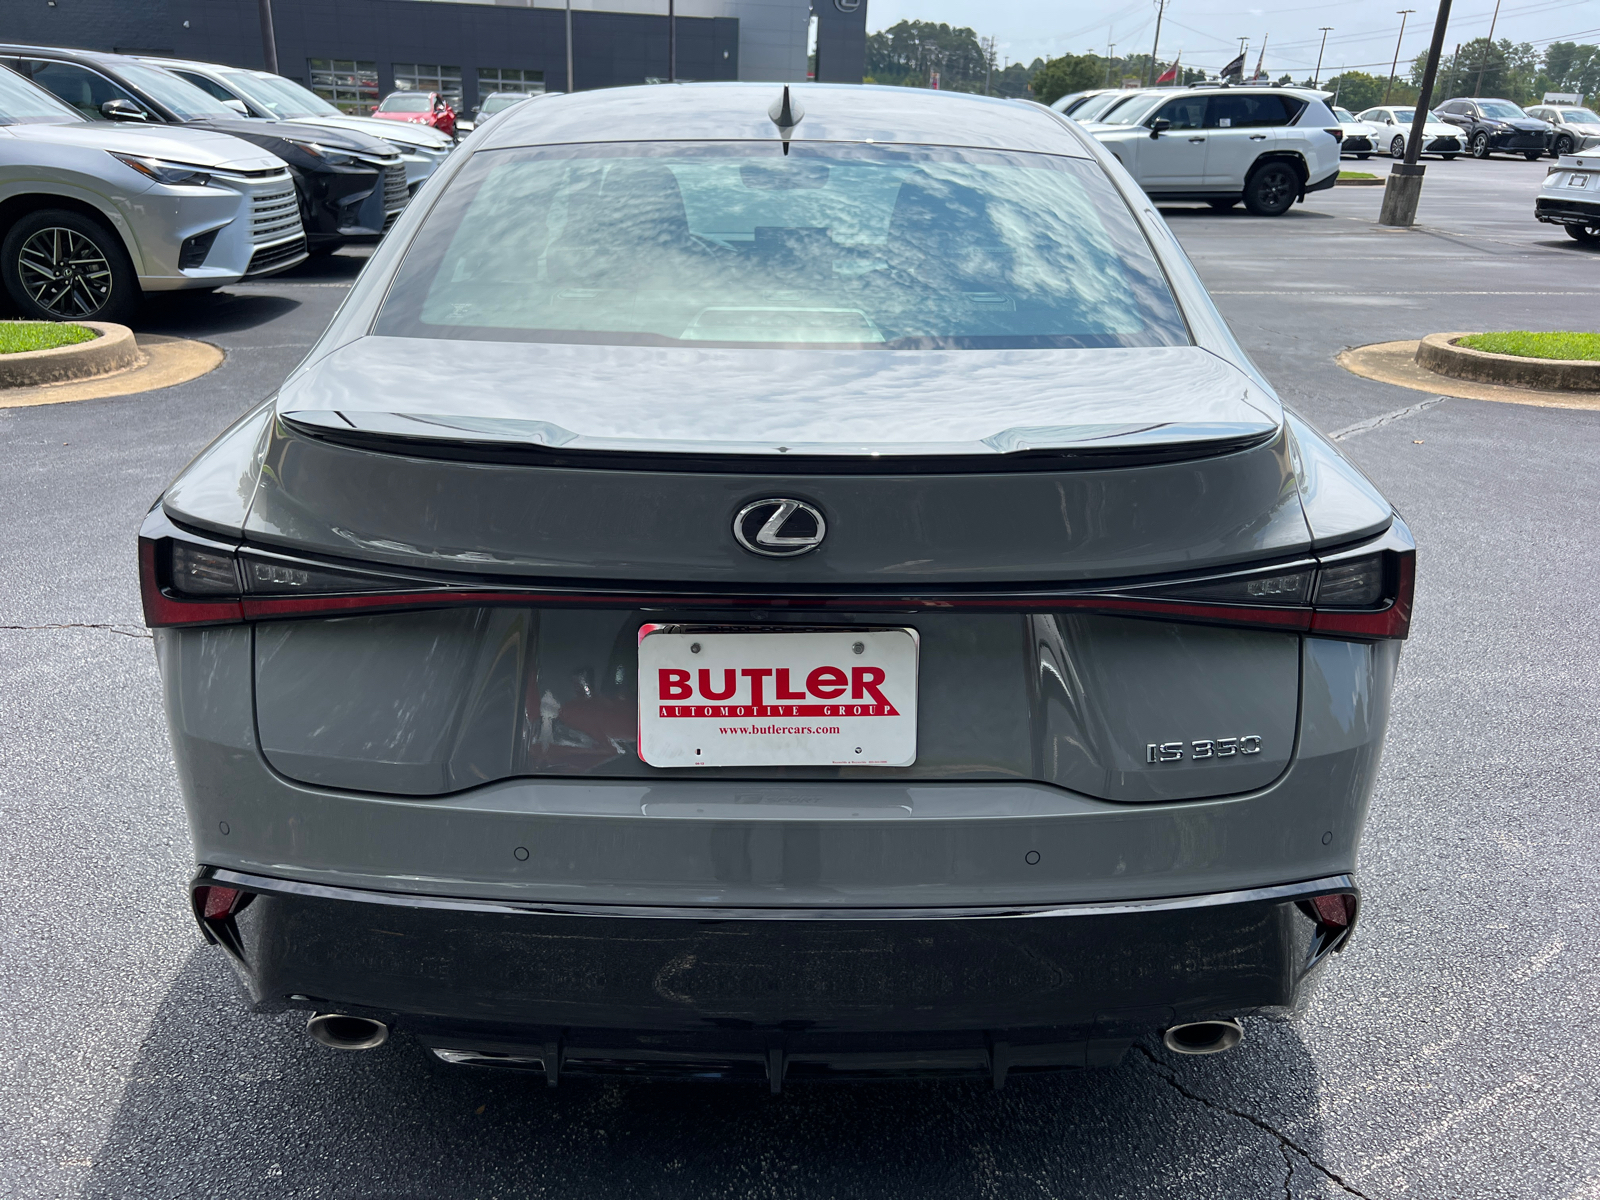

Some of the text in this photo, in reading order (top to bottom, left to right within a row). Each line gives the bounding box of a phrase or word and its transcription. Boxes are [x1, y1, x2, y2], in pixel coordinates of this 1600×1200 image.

[660, 705, 891, 716] AUTOMOTIVE GROUP
[719, 724, 841, 735] www.butlercars.com
[1146, 735, 1263, 763] IS 350
